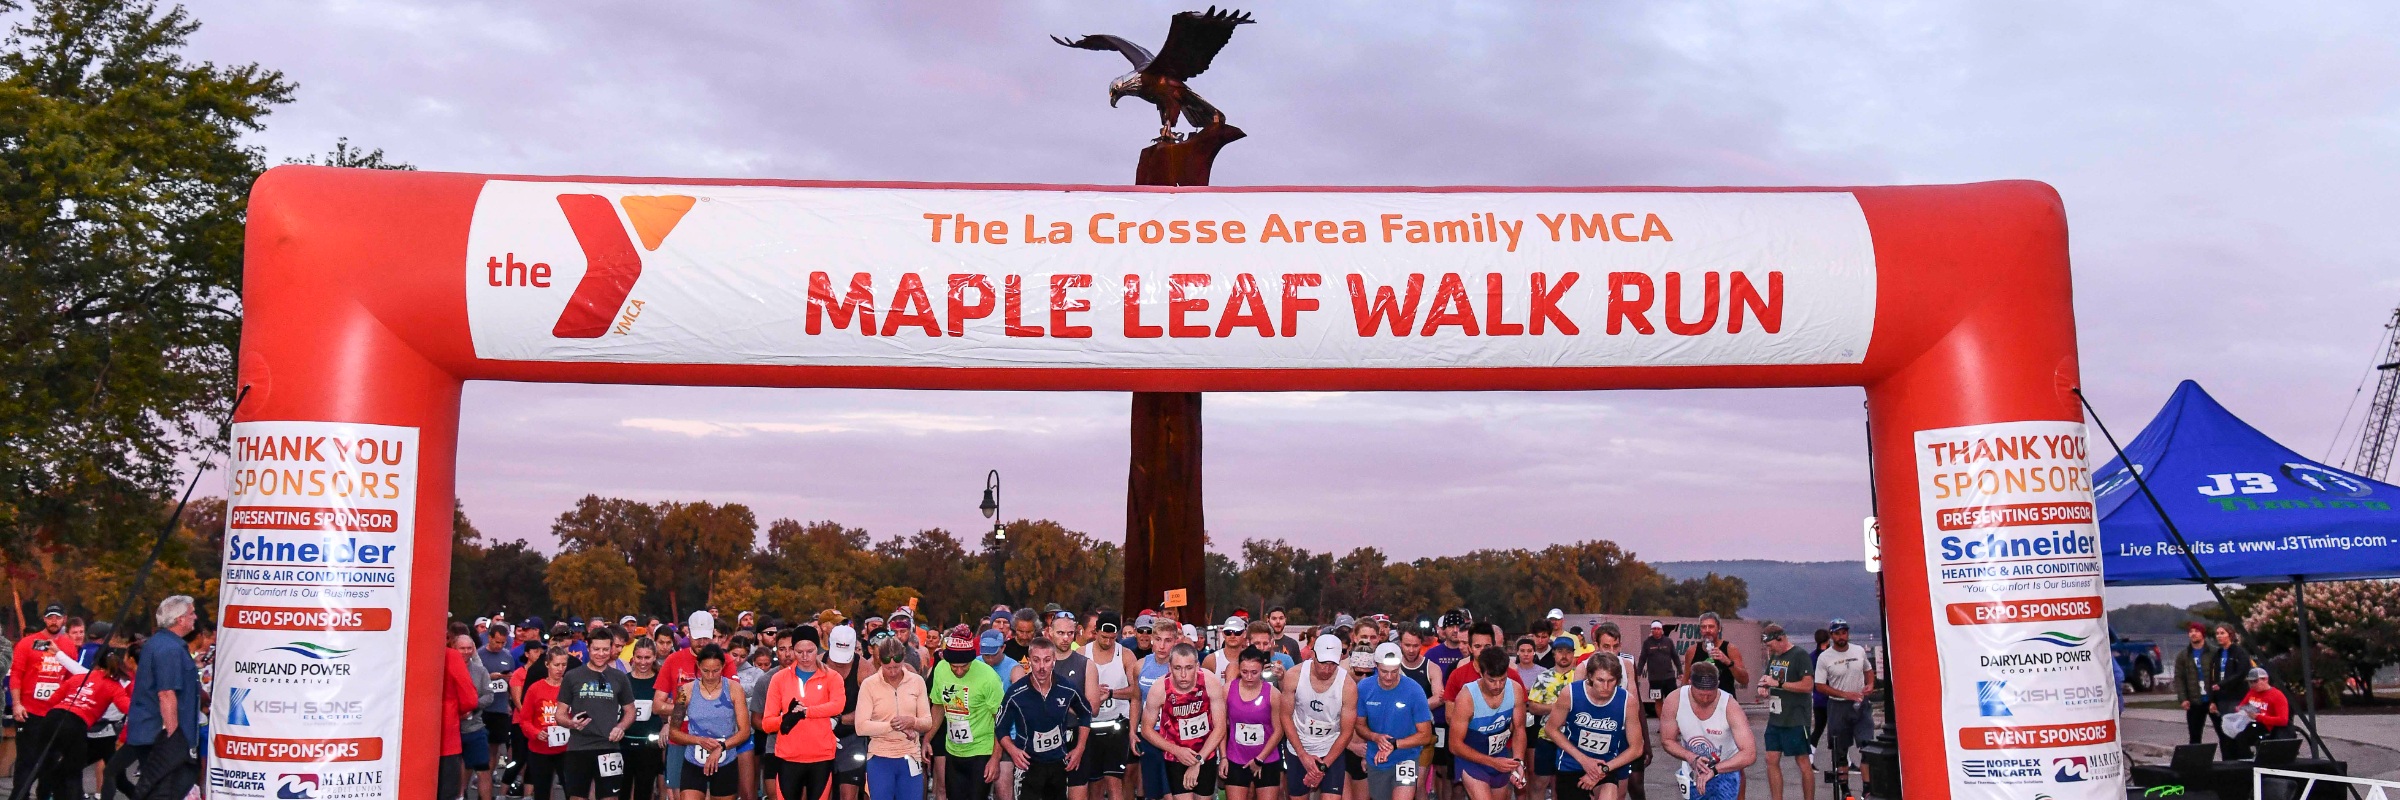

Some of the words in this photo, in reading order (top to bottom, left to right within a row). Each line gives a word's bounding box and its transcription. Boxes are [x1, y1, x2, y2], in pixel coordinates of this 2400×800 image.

[923, 212, 1008, 244] The
[1025, 213, 1073, 244] La
[1089, 212, 1247, 244] Crosse
[1260, 212, 1367, 244] Area
[1380, 212, 1524, 252] Family
[1537, 212, 1673, 243] YMCA
[486, 252, 552, 289] the
[805, 271, 1093, 338] MAPLE
[1124, 272, 1322, 339] LEAF
[1346, 271, 1580, 338] WALK
[1606, 270, 1784, 336] RUN
[613, 299, 646, 336] YMCA
[236, 435, 326, 462] THANK
[333, 437, 403, 466] YOU
[1927, 435, 2041, 467] THANK
[2043, 434, 2086, 460] YOU
[234, 468, 400, 499] SPONSORS
[1933, 466, 2090, 499] SPONSORS
[2197, 472, 2278, 496] J3
[233, 510, 310, 525] PRESENTING
[313, 511, 392, 528] SPONSOR
[1943, 507, 2038, 526] PRESENTING
[2041, 506, 2091, 521] SPONSOR
[230, 535, 397, 564] Schneider
[1941, 530, 2095, 561] Schneider
[2121, 543, 2152, 557] Live
[2219, 539, 2235, 553] at
[2238, 534, 2387, 553] www.J3Timing.com
[227, 569, 259, 581] HEATING
[262, 570, 271, 580] &
[273, 570, 294, 581] AIR
[296, 570, 395, 583] CONDITIONING
[1942, 566, 1996, 579] HEATING
[2000, 566, 2009, 576] &
[2012, 564, 2034, 576] AIR
[2036, 562, 2100, 575] CONDITIONING
[253, 586, 287, 596] Comfort
[290, 588, 298, 597] Is
[301, 588, 319, 598] Our
[1991, 582, 2030, 592] Comfort
[2033, 581, 2041, 590] Is
[2043, 580, 2059, 589] Our
[238, 610, 271, 626] EXPO
[273, 610, 363, 627] SPONSORS
[1975, 605, 2018, 621] EXPO
[2020, 601, 2091, 618] SPONSORS
[1980, 652, 2053, 667] DAIRYLAND
[2056, 650, 2092, 664] POWER
[235, 660, 297, 676] DAIRYLAND
[300, 663, 351, 676] POWER
[2001, 665, 2080, 674] COOPERATIVE
[2014, 687, 2058, 703] KISH
[2063, 685, 2104, 700] SONS
[253, 700, 297, 714] KISH
[303, 700, 363, 714] SONS
[1172, 700, 1205, 718] MIDWEST
[1182, 720, 1208, 736] 184
[1574, 712, 1618, 731] Drake
[950, 728, 969, 740] 142
[1243, 731, 1257, 742] 14
[1308, 726, 1332, 736] 127
[1984, 730, 2037, 746] EVENT
[2039, 725, 2107, 744] SPONSORS
[226, 740, 267, 757] EVENT
[268, 742, 359, 758] SPONSORS
[1036, 734, 1060, 748] 198
[1579, 737, 1608, 751] 227
[602, 760, 623, 773] 164
[1986, 758, 2041, 768] NORPLEX
[2089, 751, 2120, 768] MARINE
[223, 769, 266, 781] NORPLEX
[321, 770, 383, 785] MARINE
[1398, 766, 1415, 777] 65
[1987, 768, 2042, 778] MICARTA
